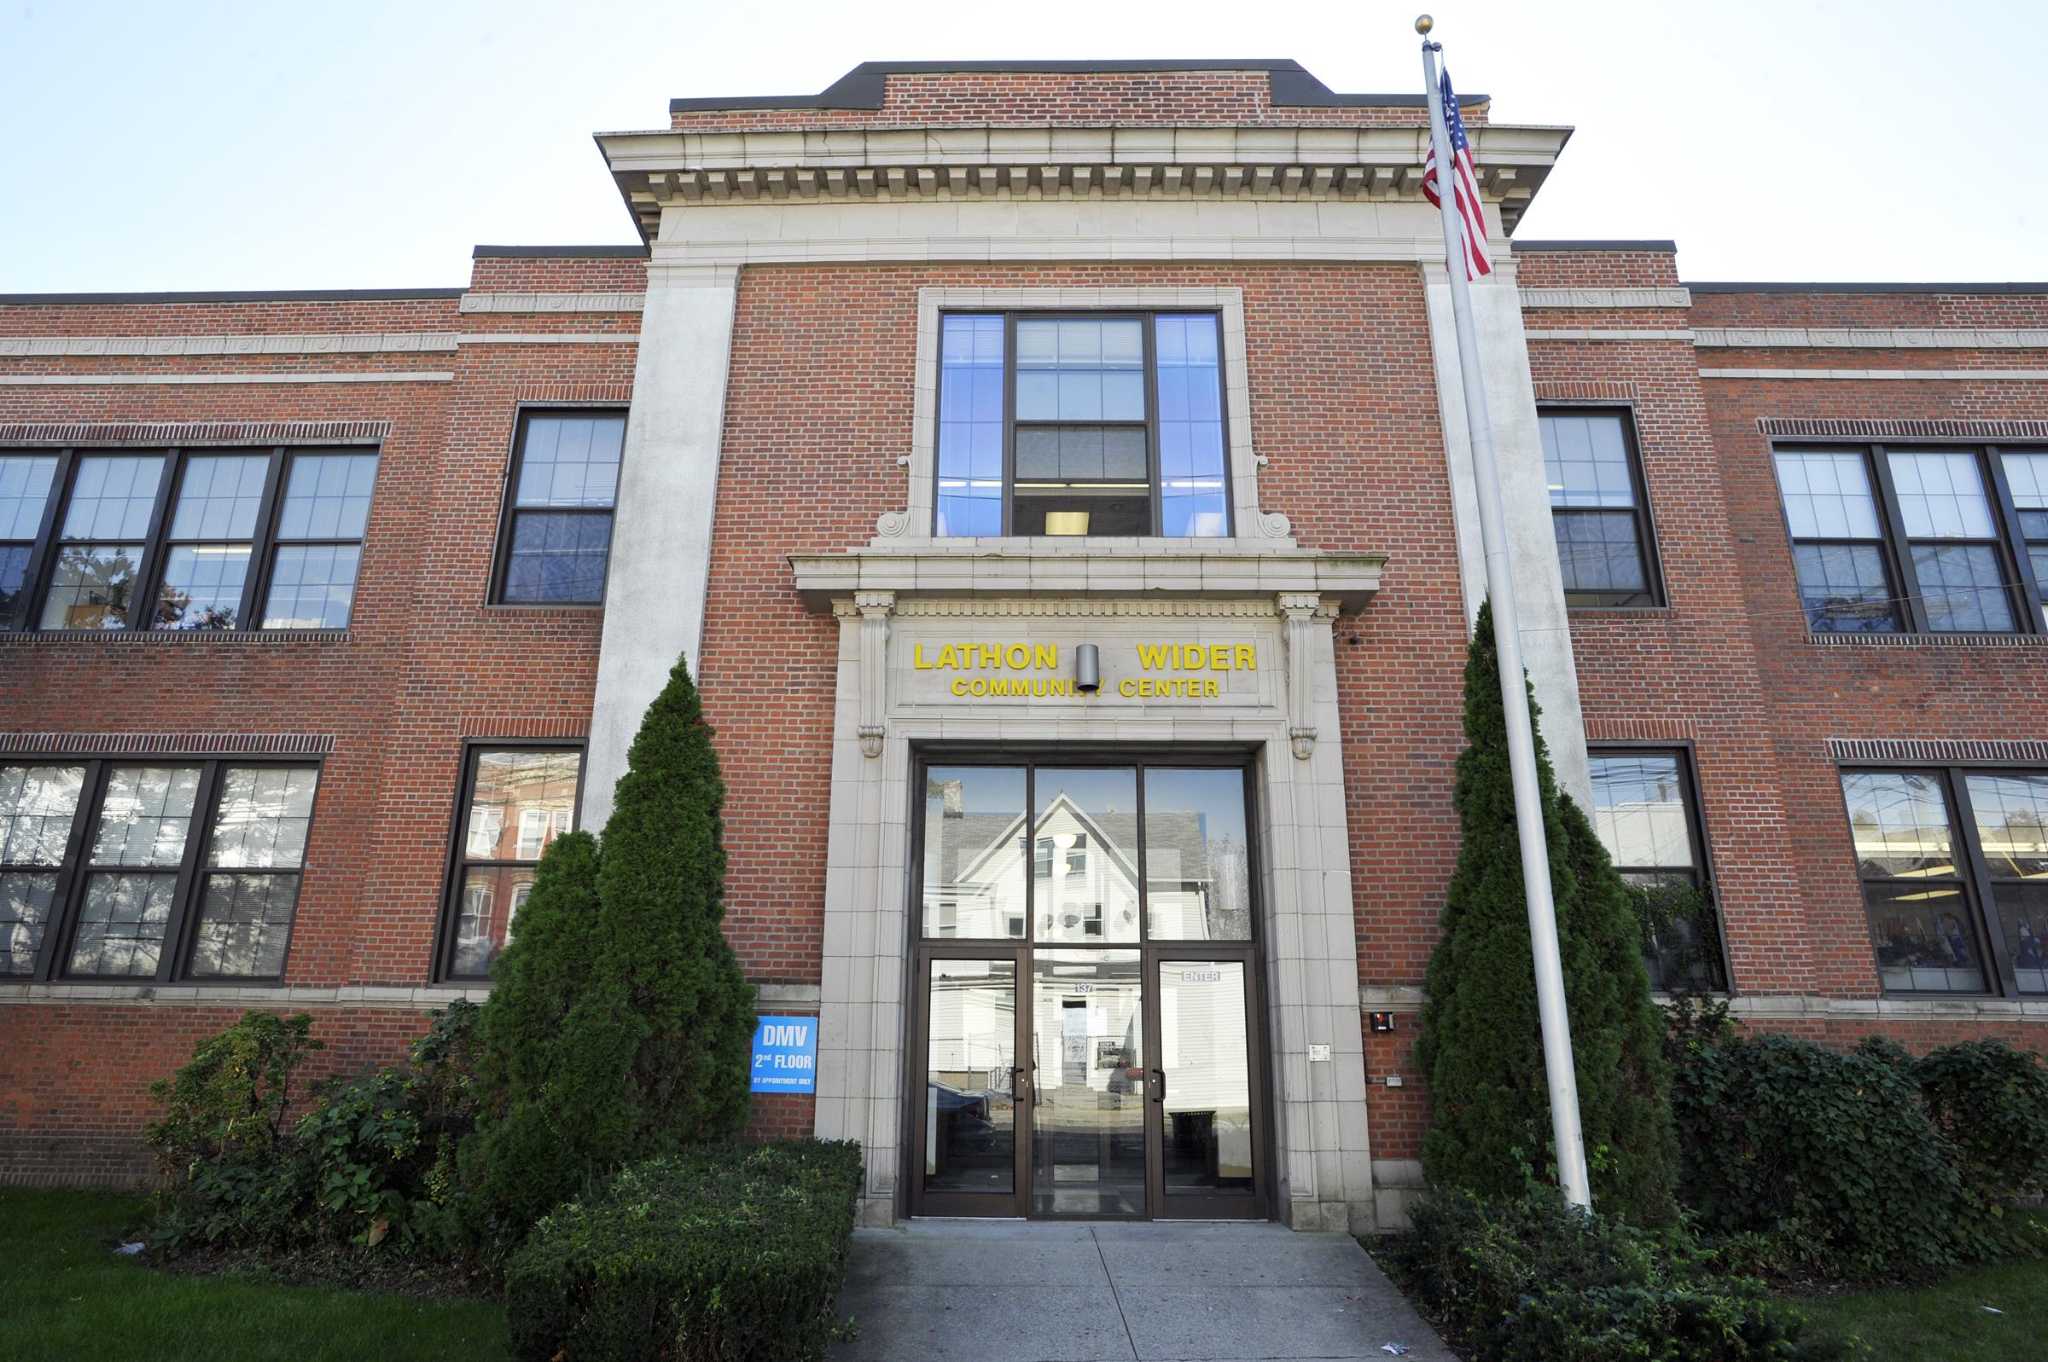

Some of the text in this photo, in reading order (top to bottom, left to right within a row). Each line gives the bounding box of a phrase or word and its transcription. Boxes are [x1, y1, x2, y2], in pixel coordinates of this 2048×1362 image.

[914, 643, 1258, 670] LATHON WIDER
[951, 677, 1219, 697] COMMUNIY CENTER
[1182, 970, 1219, 982] ENTER
[763, 1024, 808, 1047] DMV
[774, 1054, 812, 1069] FLOOR
